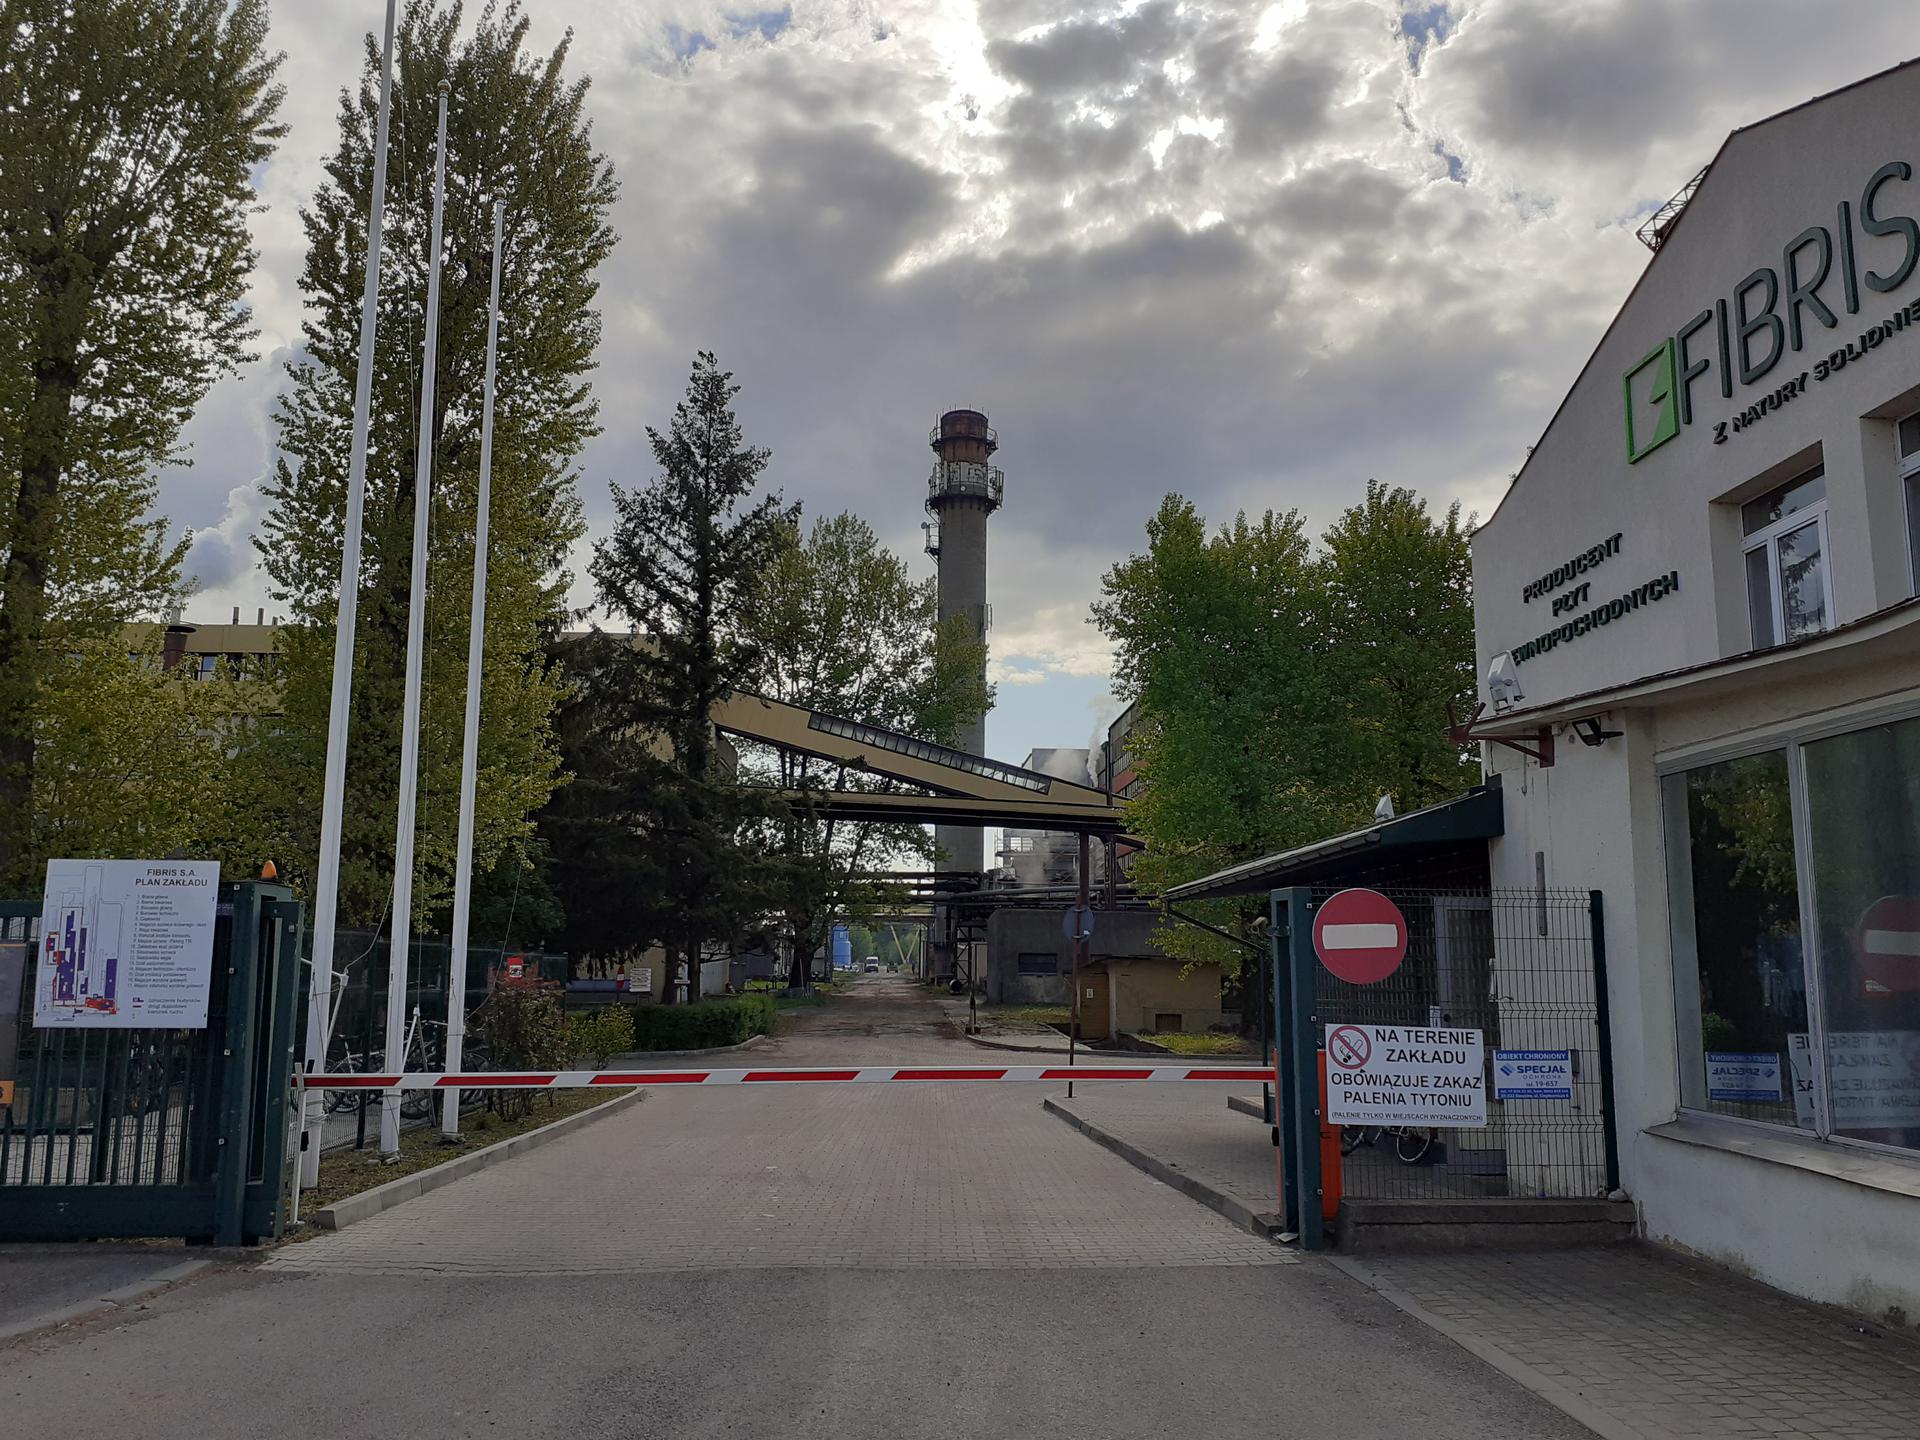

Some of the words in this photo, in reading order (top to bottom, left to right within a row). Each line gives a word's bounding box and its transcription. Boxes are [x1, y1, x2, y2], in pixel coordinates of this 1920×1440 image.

[1676, 161, 1920, 425] FIBRIS
[1713, 421, 1728, 444] Z
[1732, 371, 1809, 433] NATURY
[1813, 297, 1920, 381] SOLIDNIE
[1522, 532, 1623, 603] PRODUCENT
[1551, 582, 1591, 617] PŁYT
[1510, 570, 1679, 667] EWNOPOCHODNYCH
[146, 868, 177, 877] FIBRIS
[179, 868, 198, 877] S.A.
[135, 878, 160, 886] PLAN
[162, 878, 208, 887] ZAKŁADU
[1375, 1029, 1399, 1043] NA
[1404, 1030, 1475, 1045] TERENIE
[1386, 1049, 1466, 1064] ZAKŁADU
[1524, 1052, 1566, 1060] CHRONIONY
[1517, 1065, 1567, 1073] SPECJAŁ
[1331, 1072, 1429, 1090] OBOWIĄZUJE
[1433, 1076, 1482, 1089] ZAKAZ
[1343, 1091, 1407, 1105] PALENIA
[1410, 1093, 1472, 1107] TYTONIU
[1331, 1111, 1361, 1119] (PALENIE
